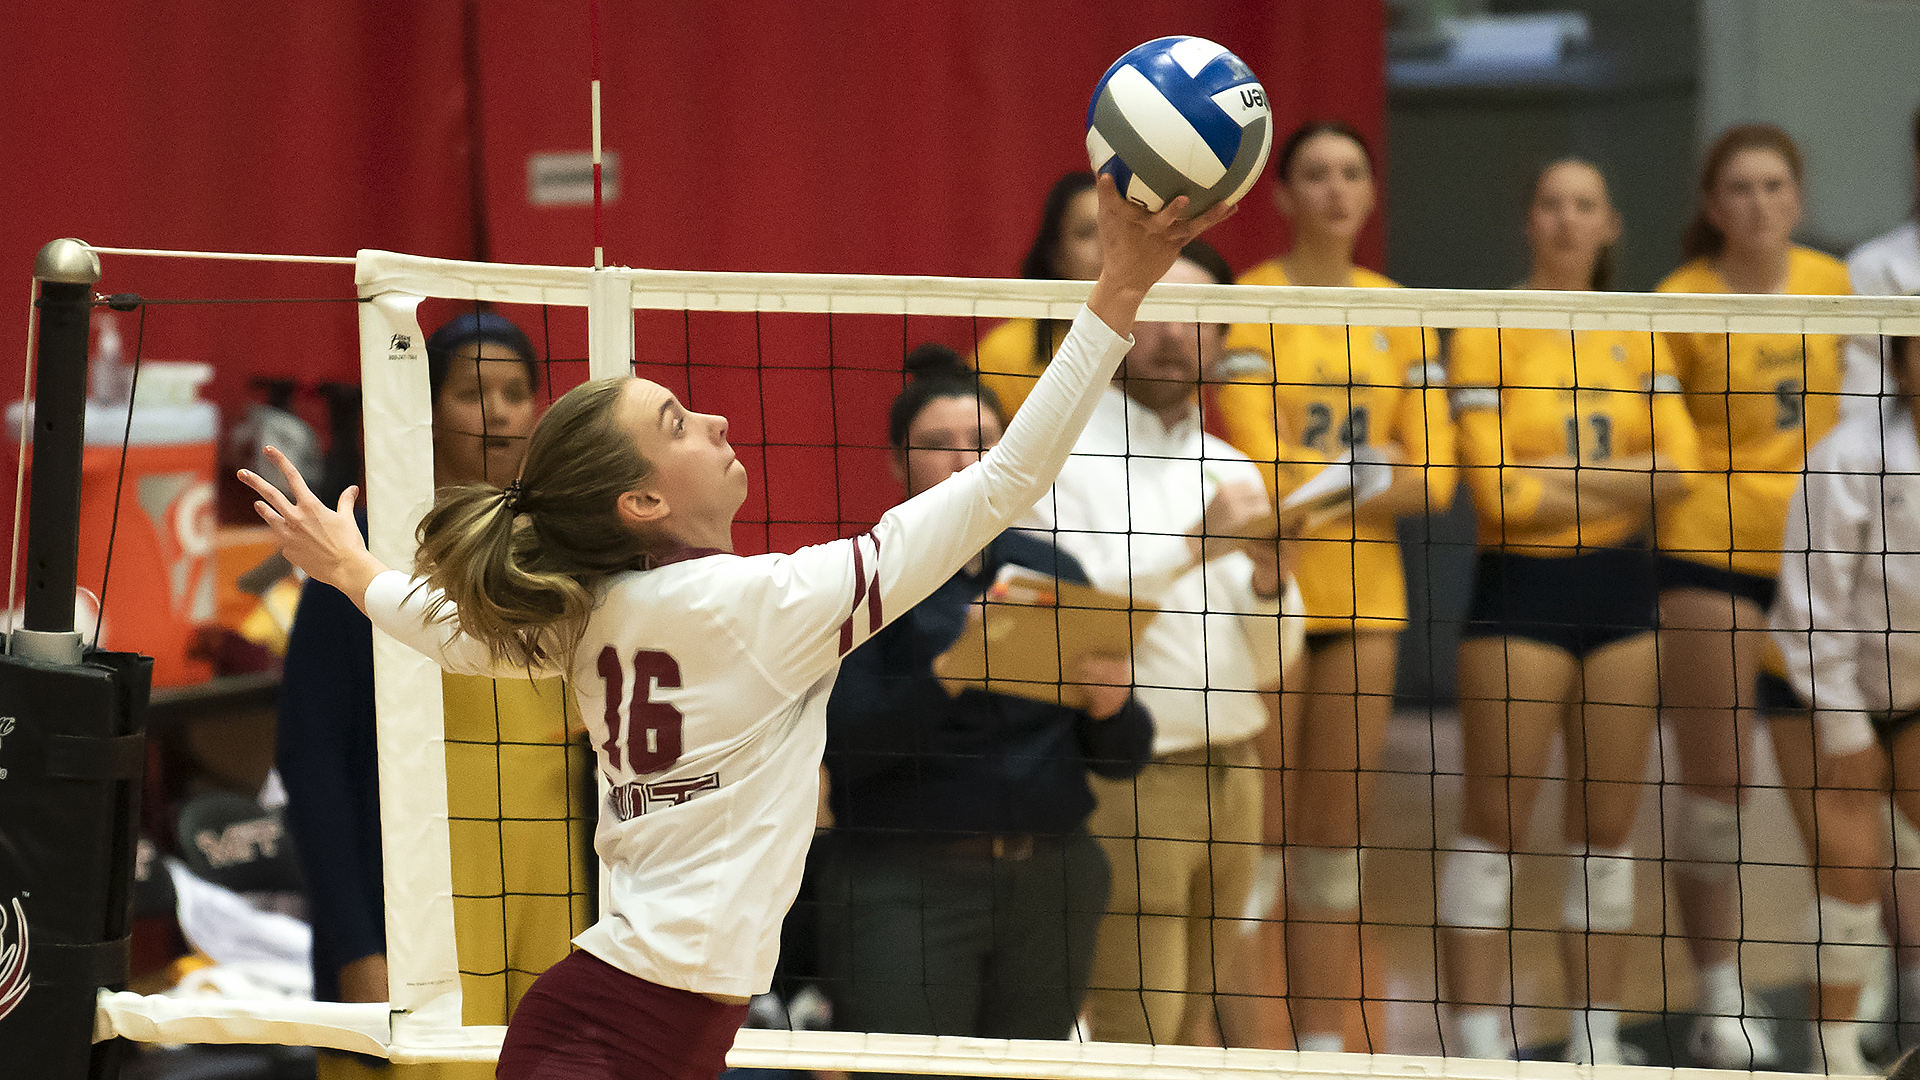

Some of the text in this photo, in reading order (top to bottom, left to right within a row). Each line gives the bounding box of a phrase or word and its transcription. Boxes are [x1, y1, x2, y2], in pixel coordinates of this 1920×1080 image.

[1301, 401, 1369, 449] 24
[1774, 377, 1801, 431] 5
[1563, 412, 1612, 462] 13
[597, 643, 684, 775] 16
